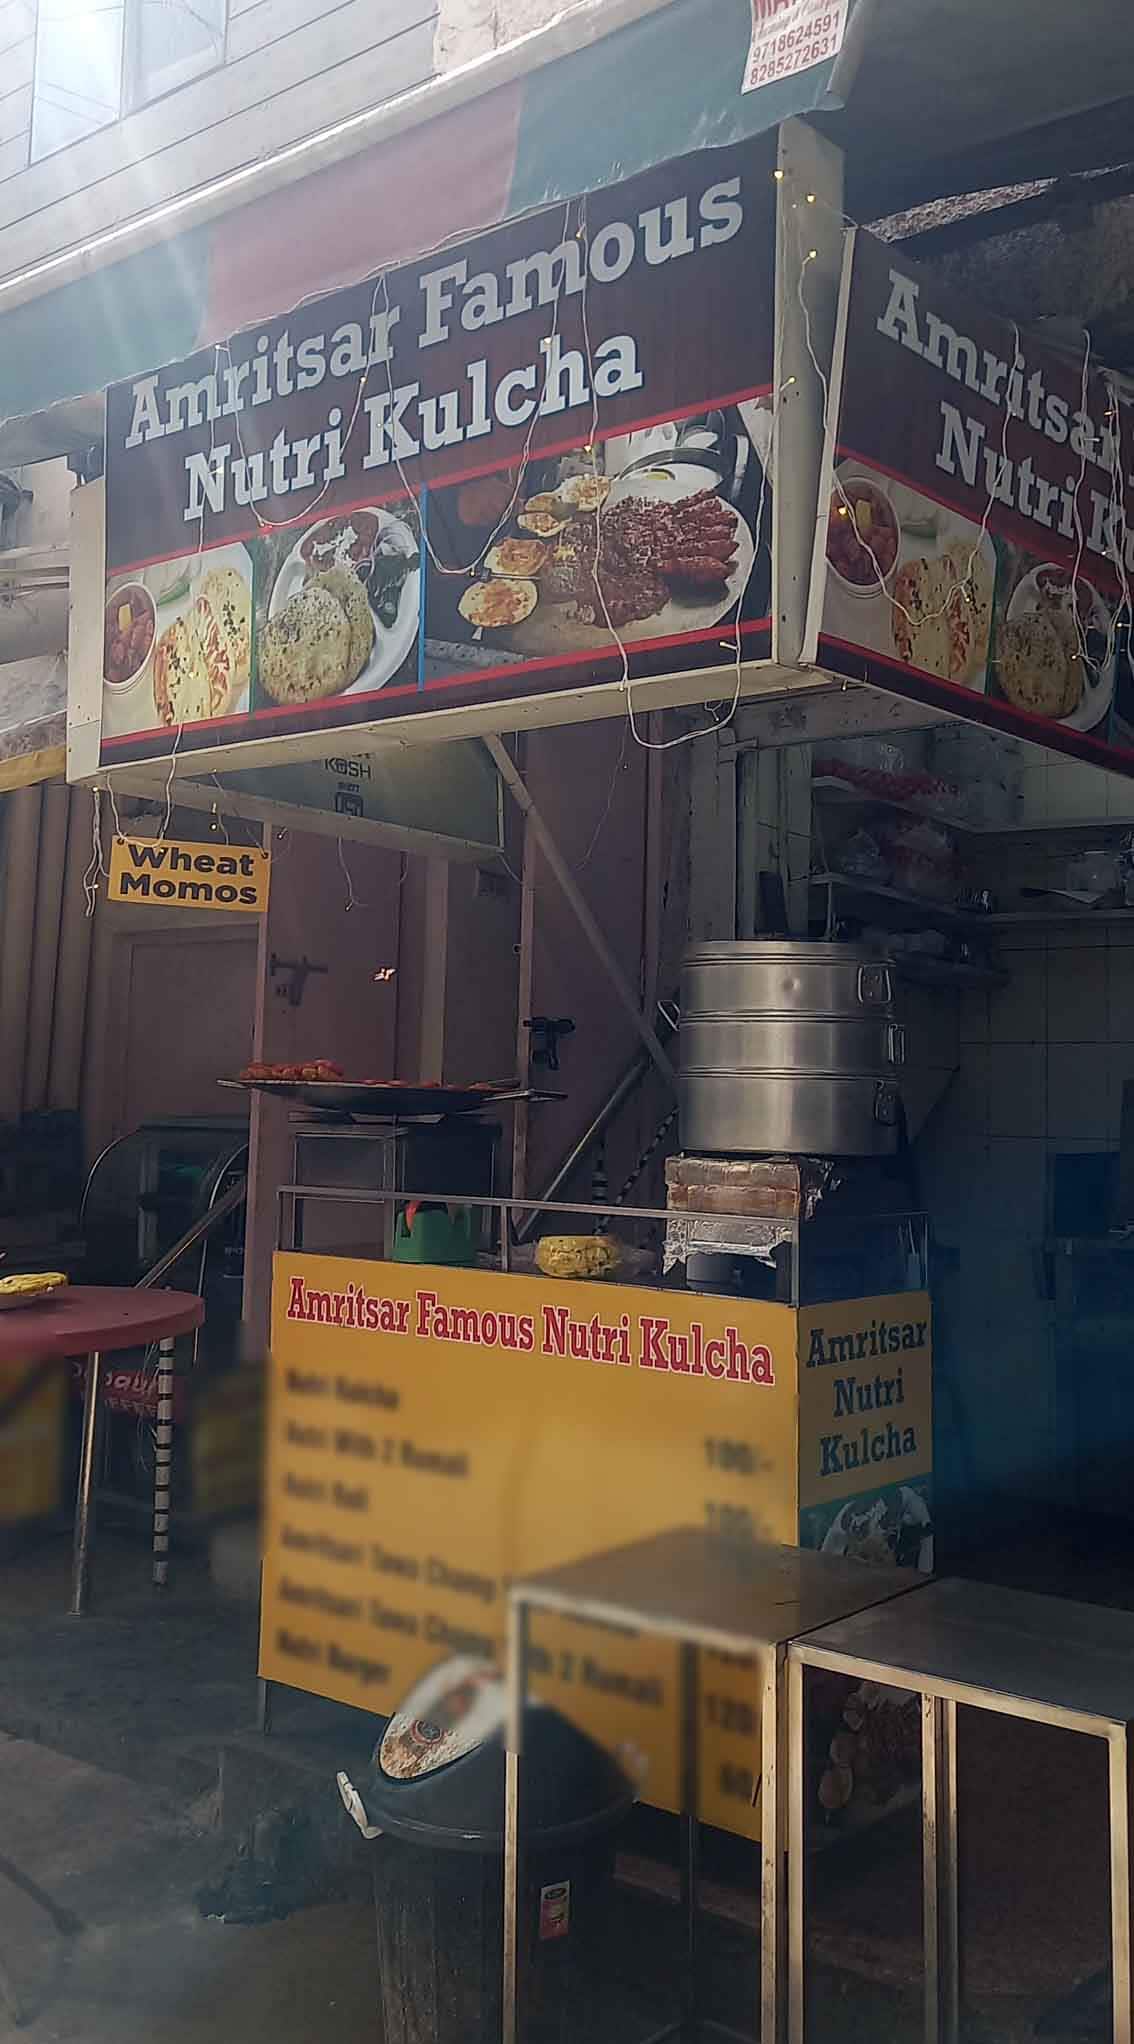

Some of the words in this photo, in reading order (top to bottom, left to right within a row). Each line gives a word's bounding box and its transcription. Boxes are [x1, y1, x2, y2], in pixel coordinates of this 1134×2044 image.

[750, 33, 837, 85] 8285272631
[753, 10, 840, 62] 9718624591
[125, 305, 403, 449] Amritsar
[418, 175, 745, 349] Famous
[876, 268, 1120, 473] Amritsar
[183, 410, 346, 522] Nutri
[364, 332, 643, 470] Kulcha
[935, 400, 1075, 539] Nutri
[127, 844, 254, 877] Wheat
[119, 872, 257, 904] Momos
[287, 1277, 409, 1334] Amritsar
[416, 1291, 534, 1351] Famous
[541, 1306, 631, 1365] Nutri
[639, 1317, 775, 1385] Kulcha
[806, 1316, 927, 1368] Amritsar
[833, 1369, 904, 1417] Nutri
[819, 1423, 917, 1477] Kulcha
